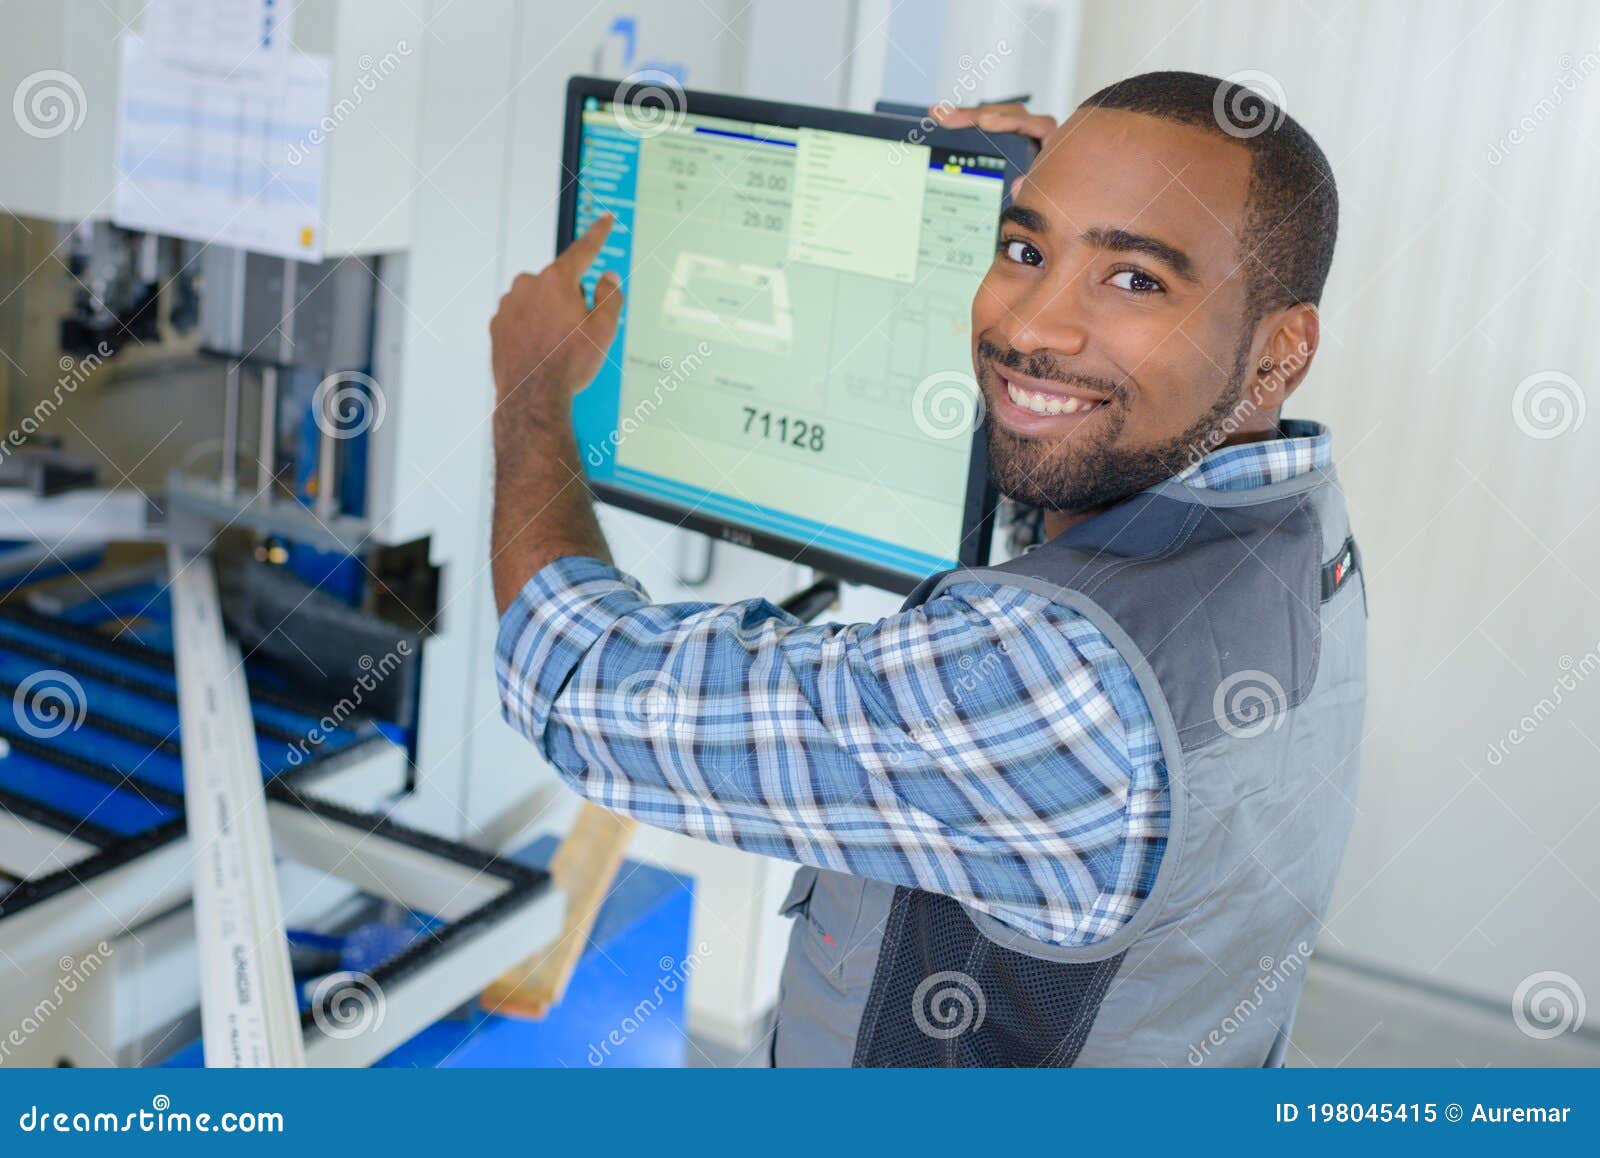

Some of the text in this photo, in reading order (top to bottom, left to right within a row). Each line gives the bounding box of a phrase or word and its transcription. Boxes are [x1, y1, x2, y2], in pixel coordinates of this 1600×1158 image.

[746, 170, 788, 192] 25.00
[742, 210, 784, 233] 25.00
[741, 406, 826, 452] 71128
